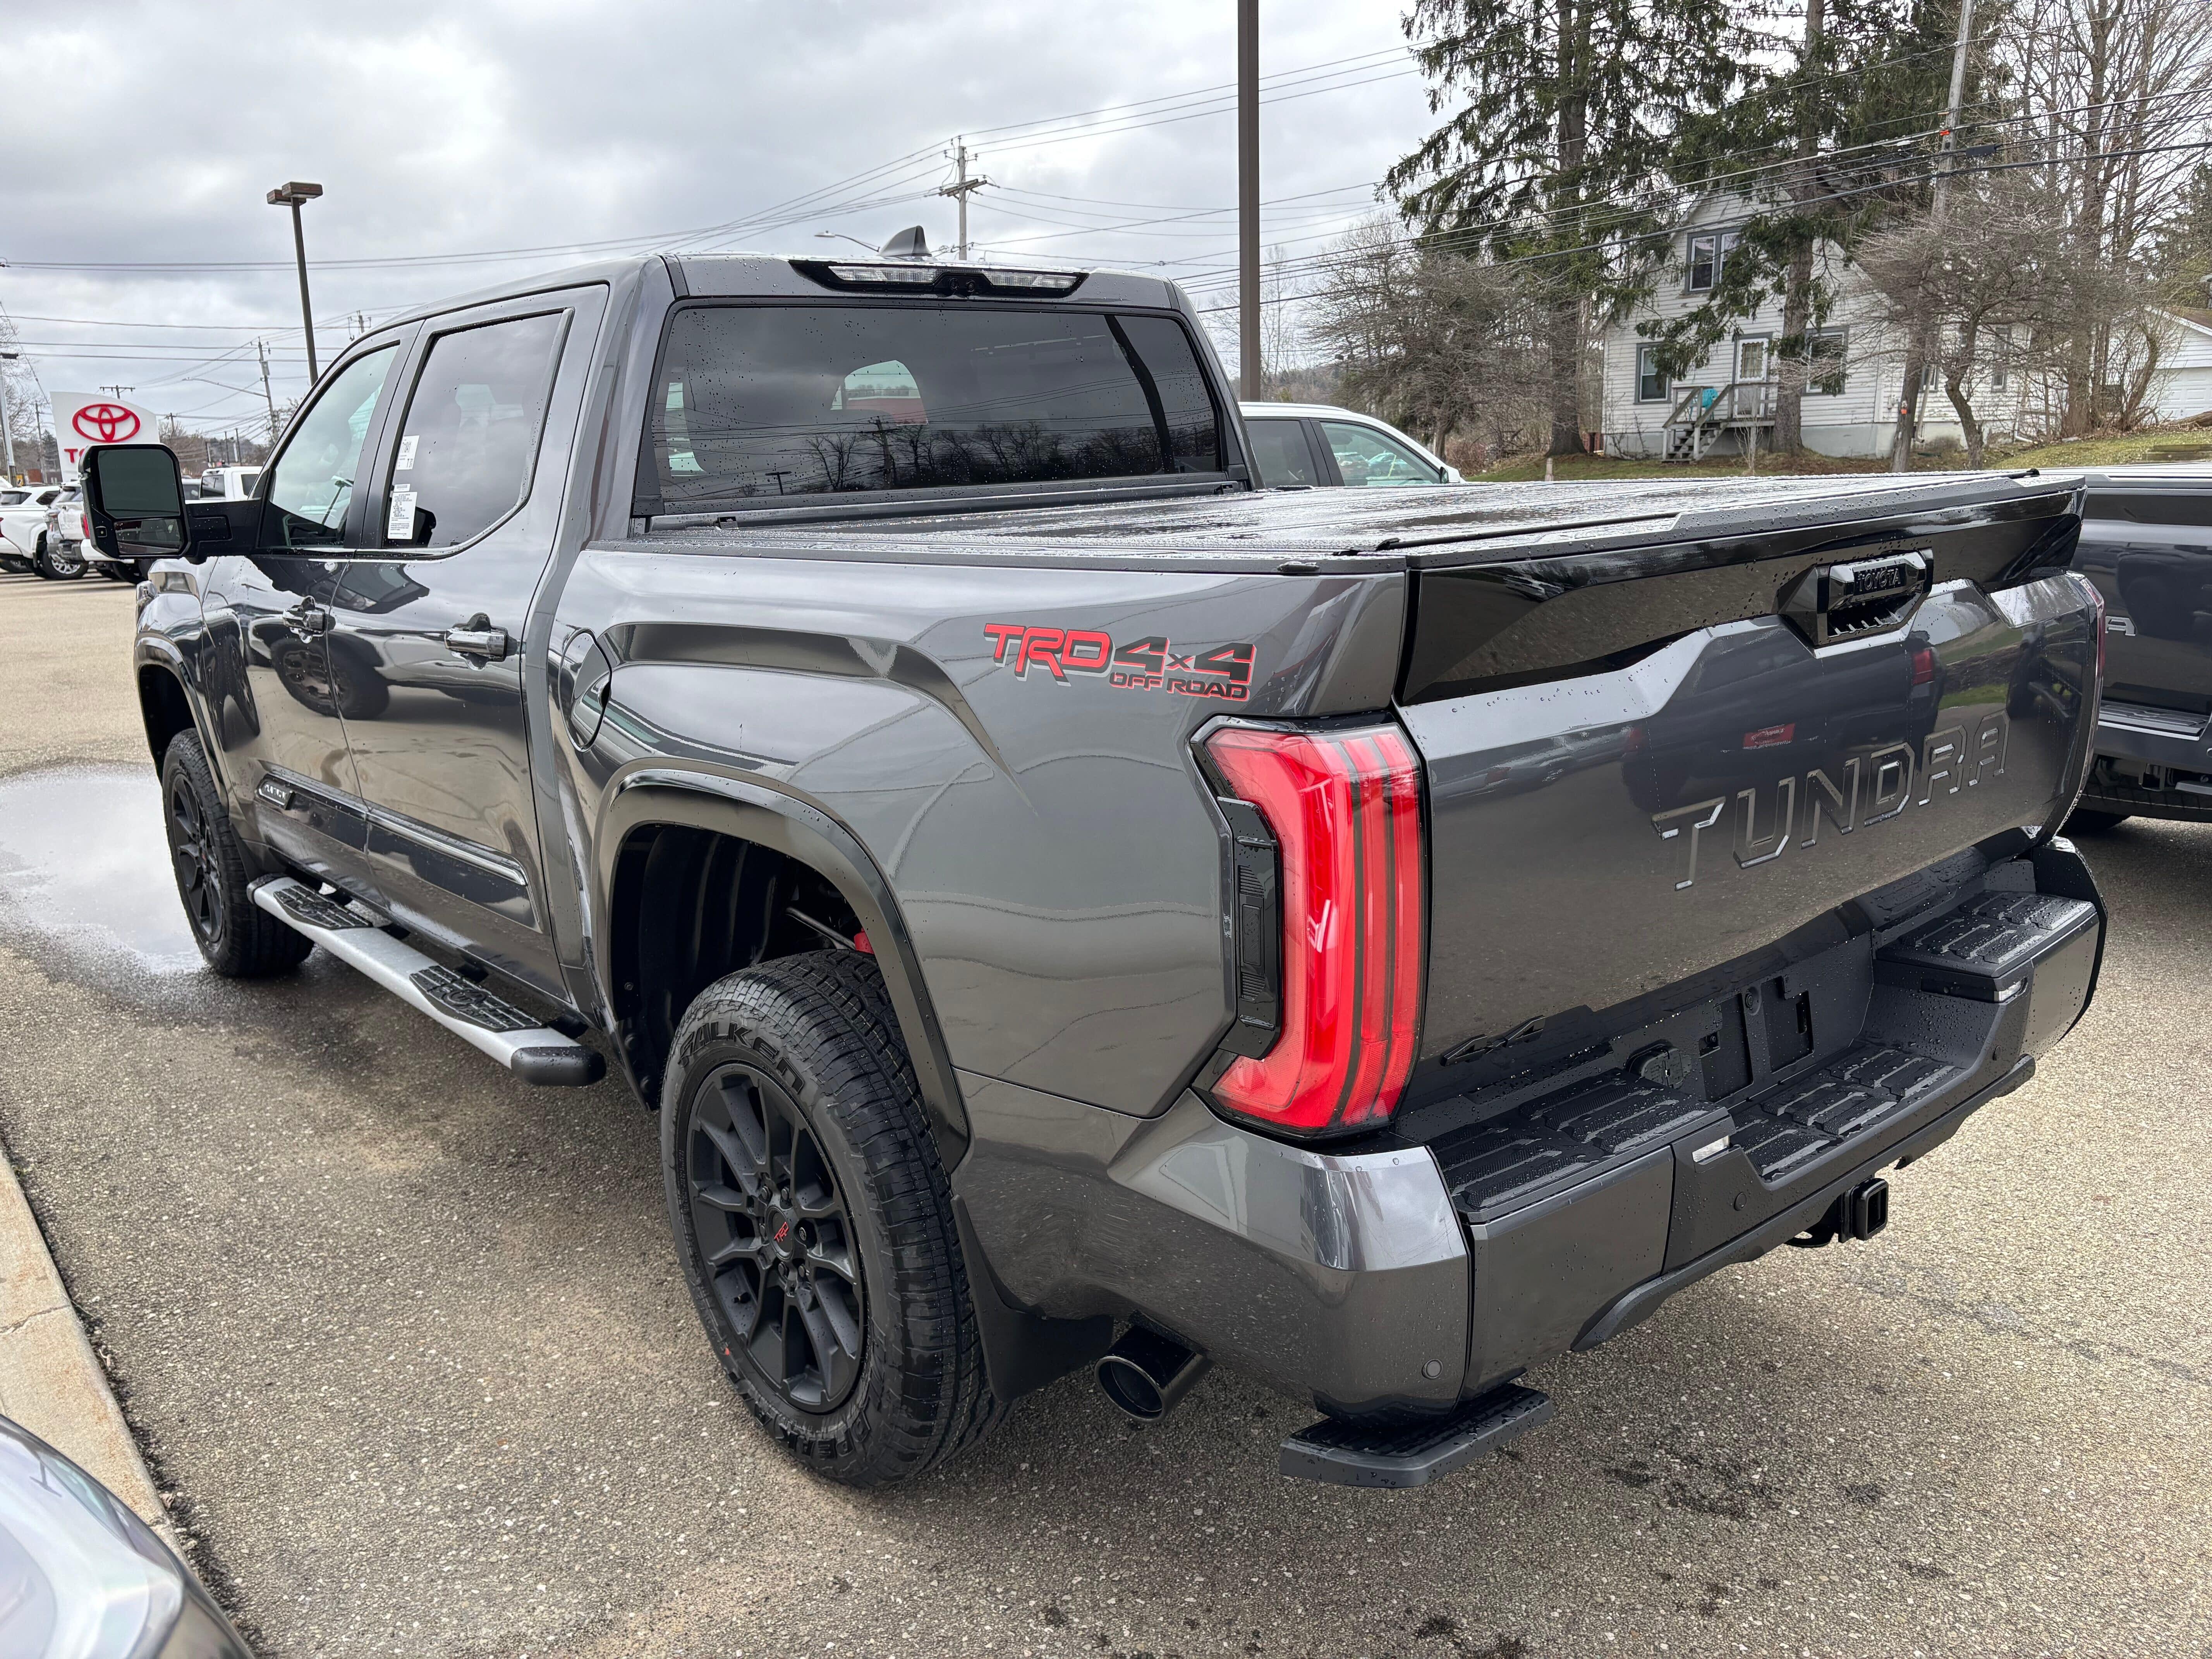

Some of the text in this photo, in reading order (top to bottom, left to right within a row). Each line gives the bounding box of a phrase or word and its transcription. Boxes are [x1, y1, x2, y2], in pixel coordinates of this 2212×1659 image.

[1857, 566, 1901, 592] TOYOTA
[984, 623, 1115, 687] TRD
[1109, 672, 1251, 701] OFF ROAD
[1651, 708, 2011, 891] TUNDRA
[774, 1221, 789, 1243] TRD
